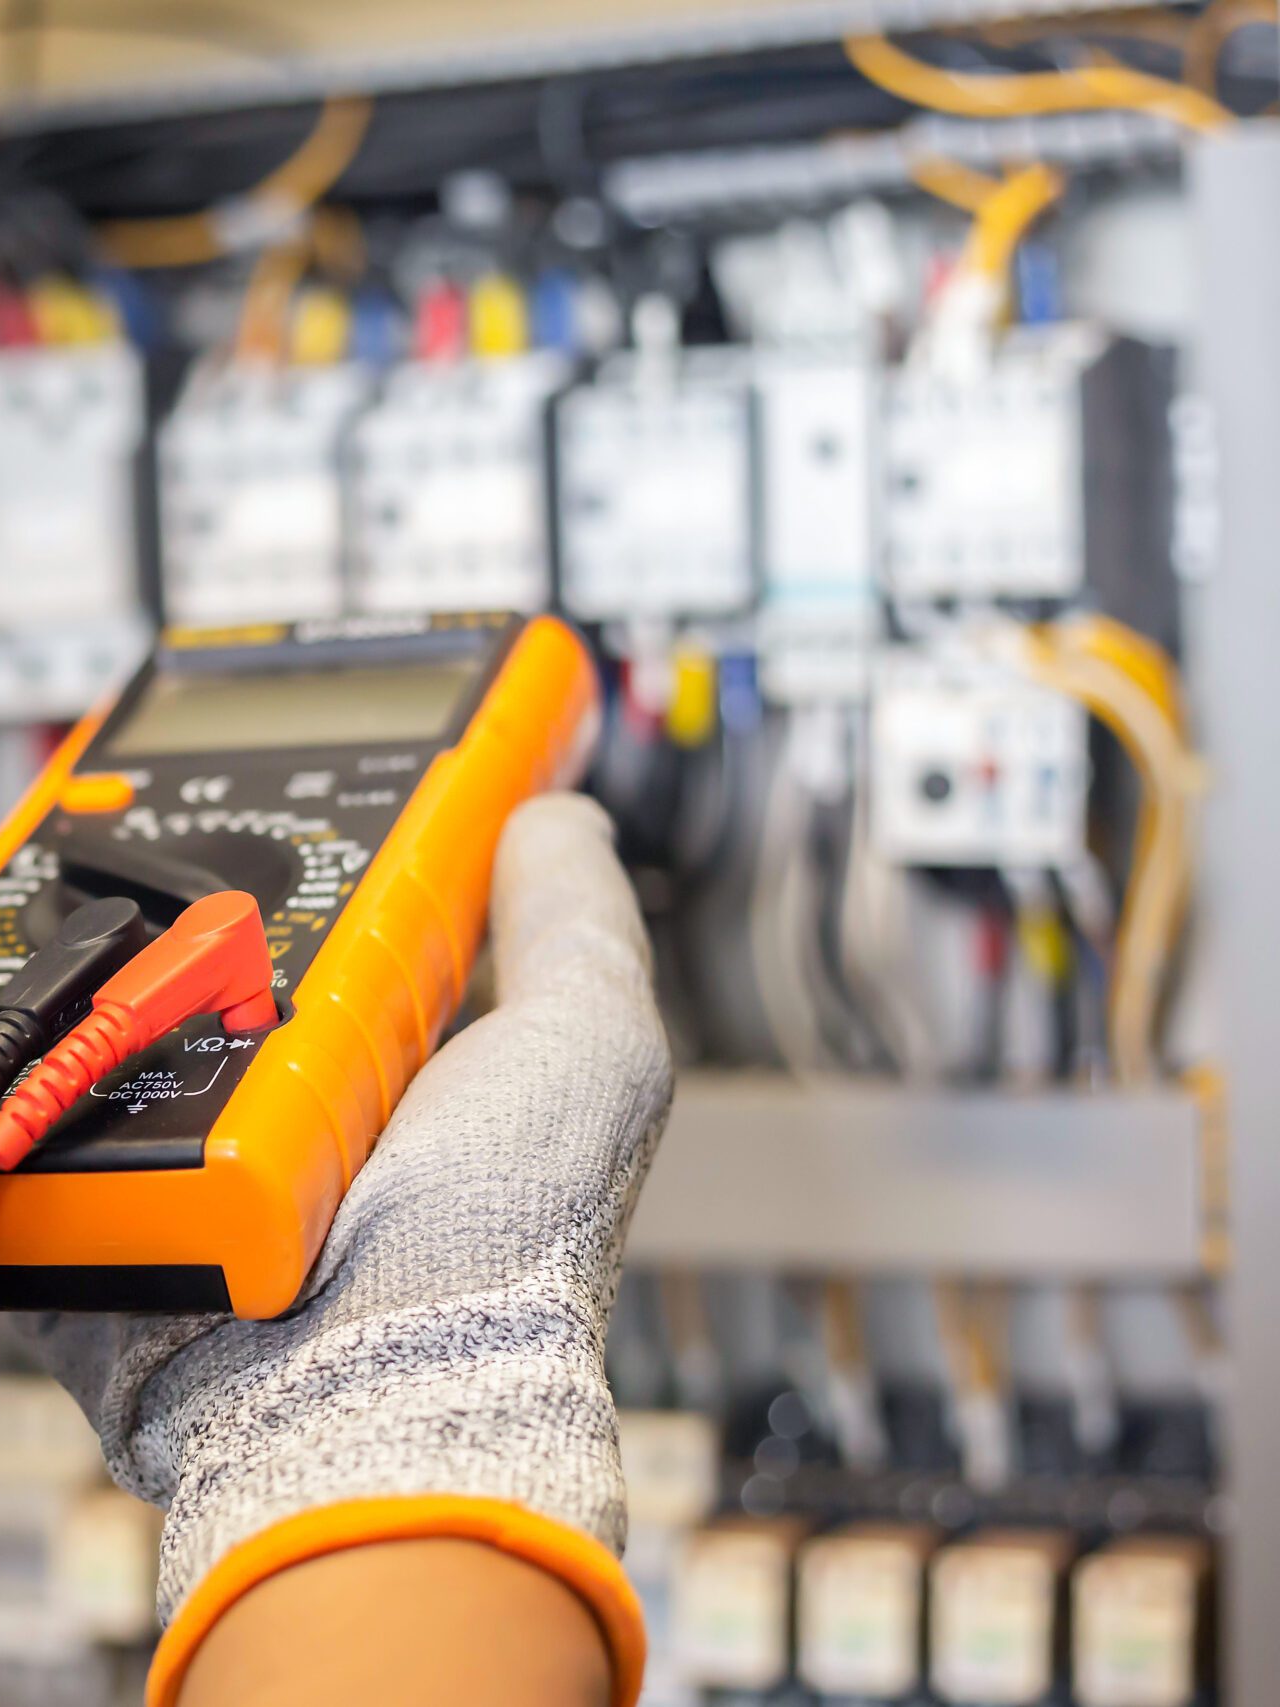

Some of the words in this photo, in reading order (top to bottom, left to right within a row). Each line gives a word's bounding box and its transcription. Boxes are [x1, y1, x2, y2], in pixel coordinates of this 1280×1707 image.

[138, 1071, 177, 1080] MAX
[118, 1080, 184, 1090] AC750V
[108, 1090, 182, 1100] DC1000V
